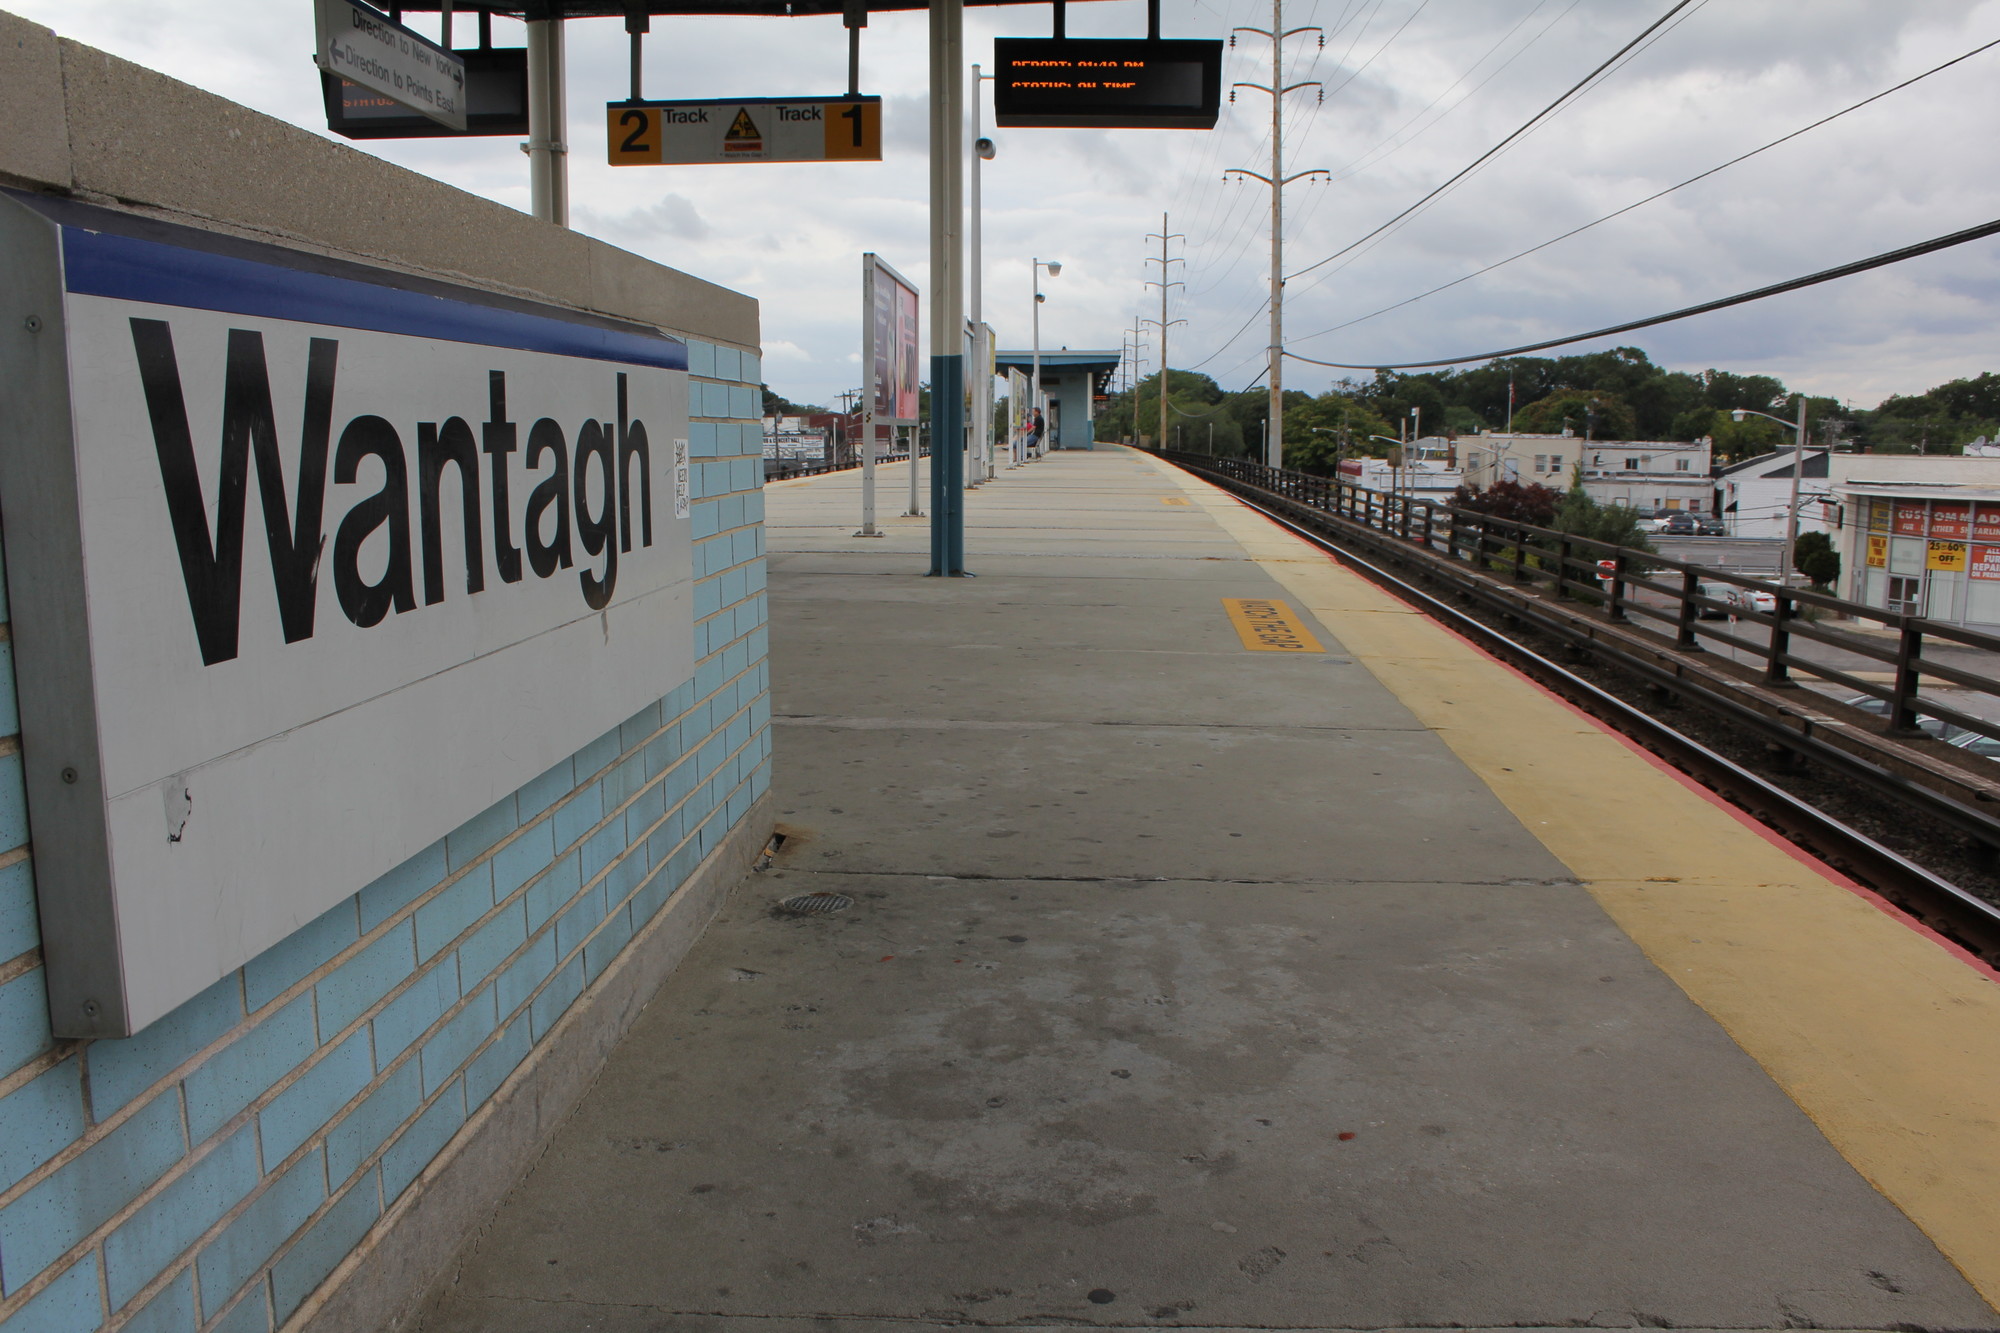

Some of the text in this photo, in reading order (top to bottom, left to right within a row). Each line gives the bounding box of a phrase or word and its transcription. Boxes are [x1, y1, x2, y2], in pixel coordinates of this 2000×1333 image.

[352, 8, 453, 76] Direction to New York
[345, 44, 455, 114] Direction to Points East
[663, 108, 708, 124] Track
[776, 105, 821, 121] Track
[619, 110, 650, 152] 2
[841, 104, 863, 147] 1
[128, 316, 653, 666] Wantagh
[1921, 524, 1954, 534] LATHER
[1972, 563, 2000, 571] REPAI
[1248, 620, 1292, 633] THE
[1258, 633, 1304, 648] GAP
